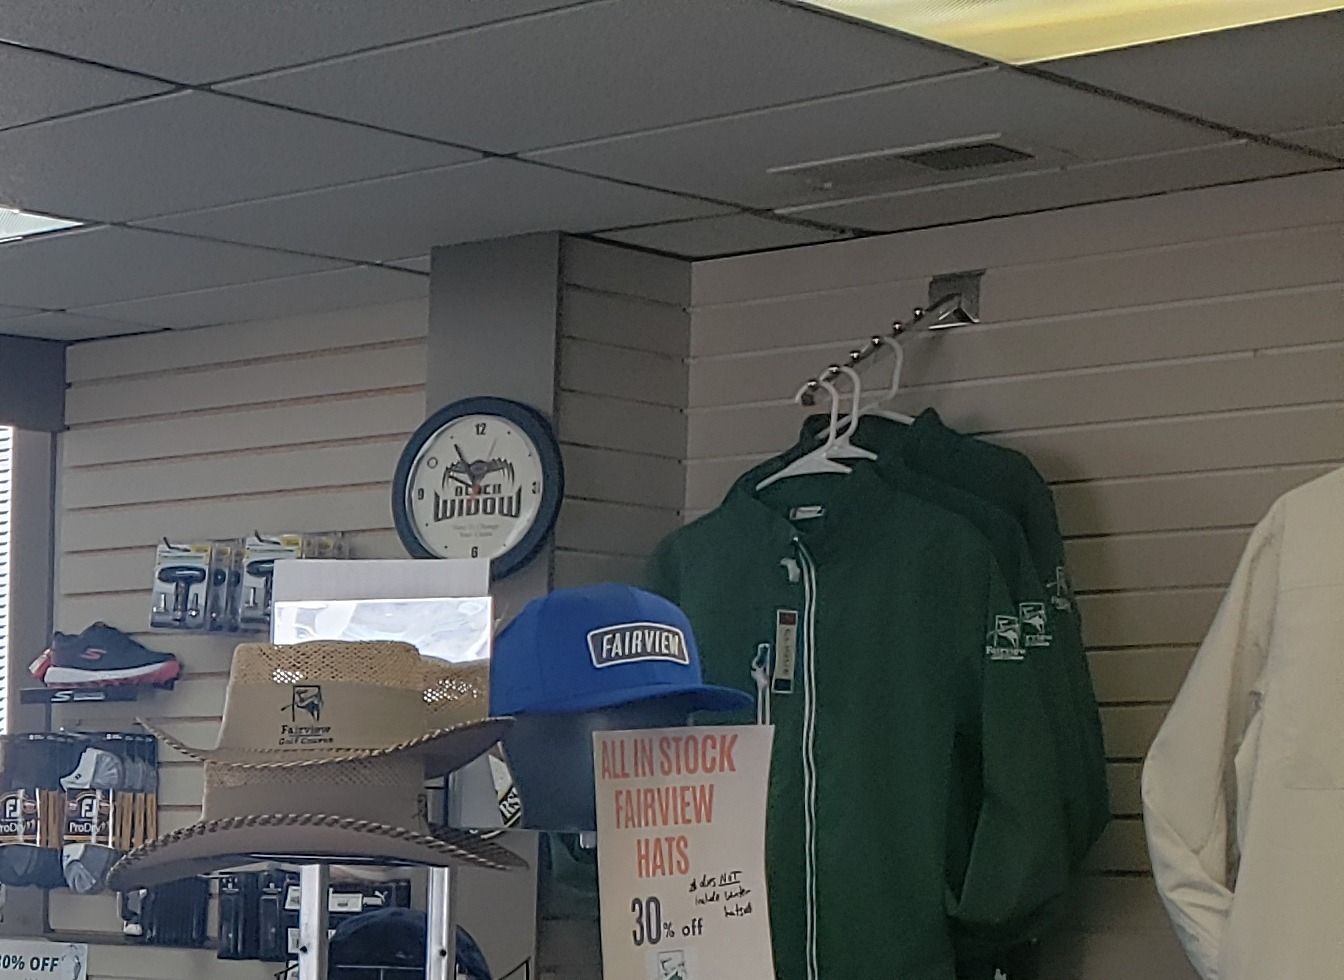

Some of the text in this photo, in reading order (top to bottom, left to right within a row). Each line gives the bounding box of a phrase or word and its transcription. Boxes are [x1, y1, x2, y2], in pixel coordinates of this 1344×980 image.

[475, 423, 487, 435] 12
[455, 484, 502, 497] BLCK
[434, 486, 522, 522] WIDOW
[471, 547, 478, 558] 6
[602, 629, 679, 659] FAIRVIEW
[602, 733, 739, 779] ALL IN STOCK
[615, 784, 714, 829] FAIRVIEW
[636, 836, 690, 878] HATS
[681, 918, 703, 936] off
[30, 956, 60, 972] OFF
